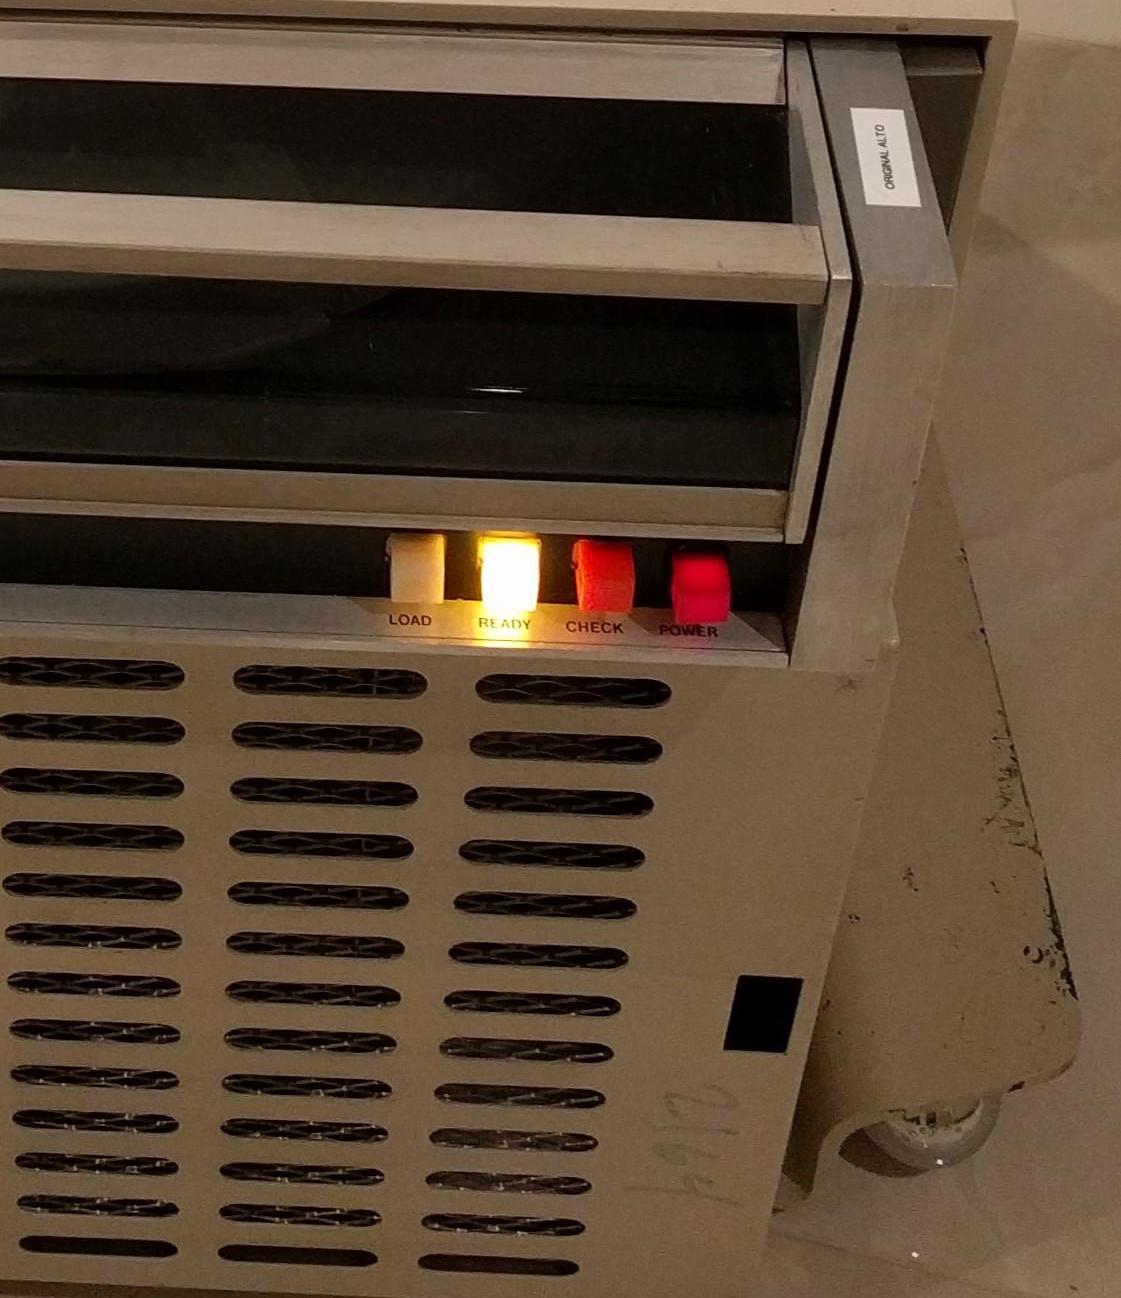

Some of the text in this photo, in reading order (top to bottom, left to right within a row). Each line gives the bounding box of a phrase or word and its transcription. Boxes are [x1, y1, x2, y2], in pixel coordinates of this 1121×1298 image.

[874, 124, 895, 190] ORIGINAL ALTO
[389, 614, 432, 627] LOAD
[478, 617, 531, 631] READY
[566, 621, 624, 635] CHECK
[659, 624, 718, 638] POWER
